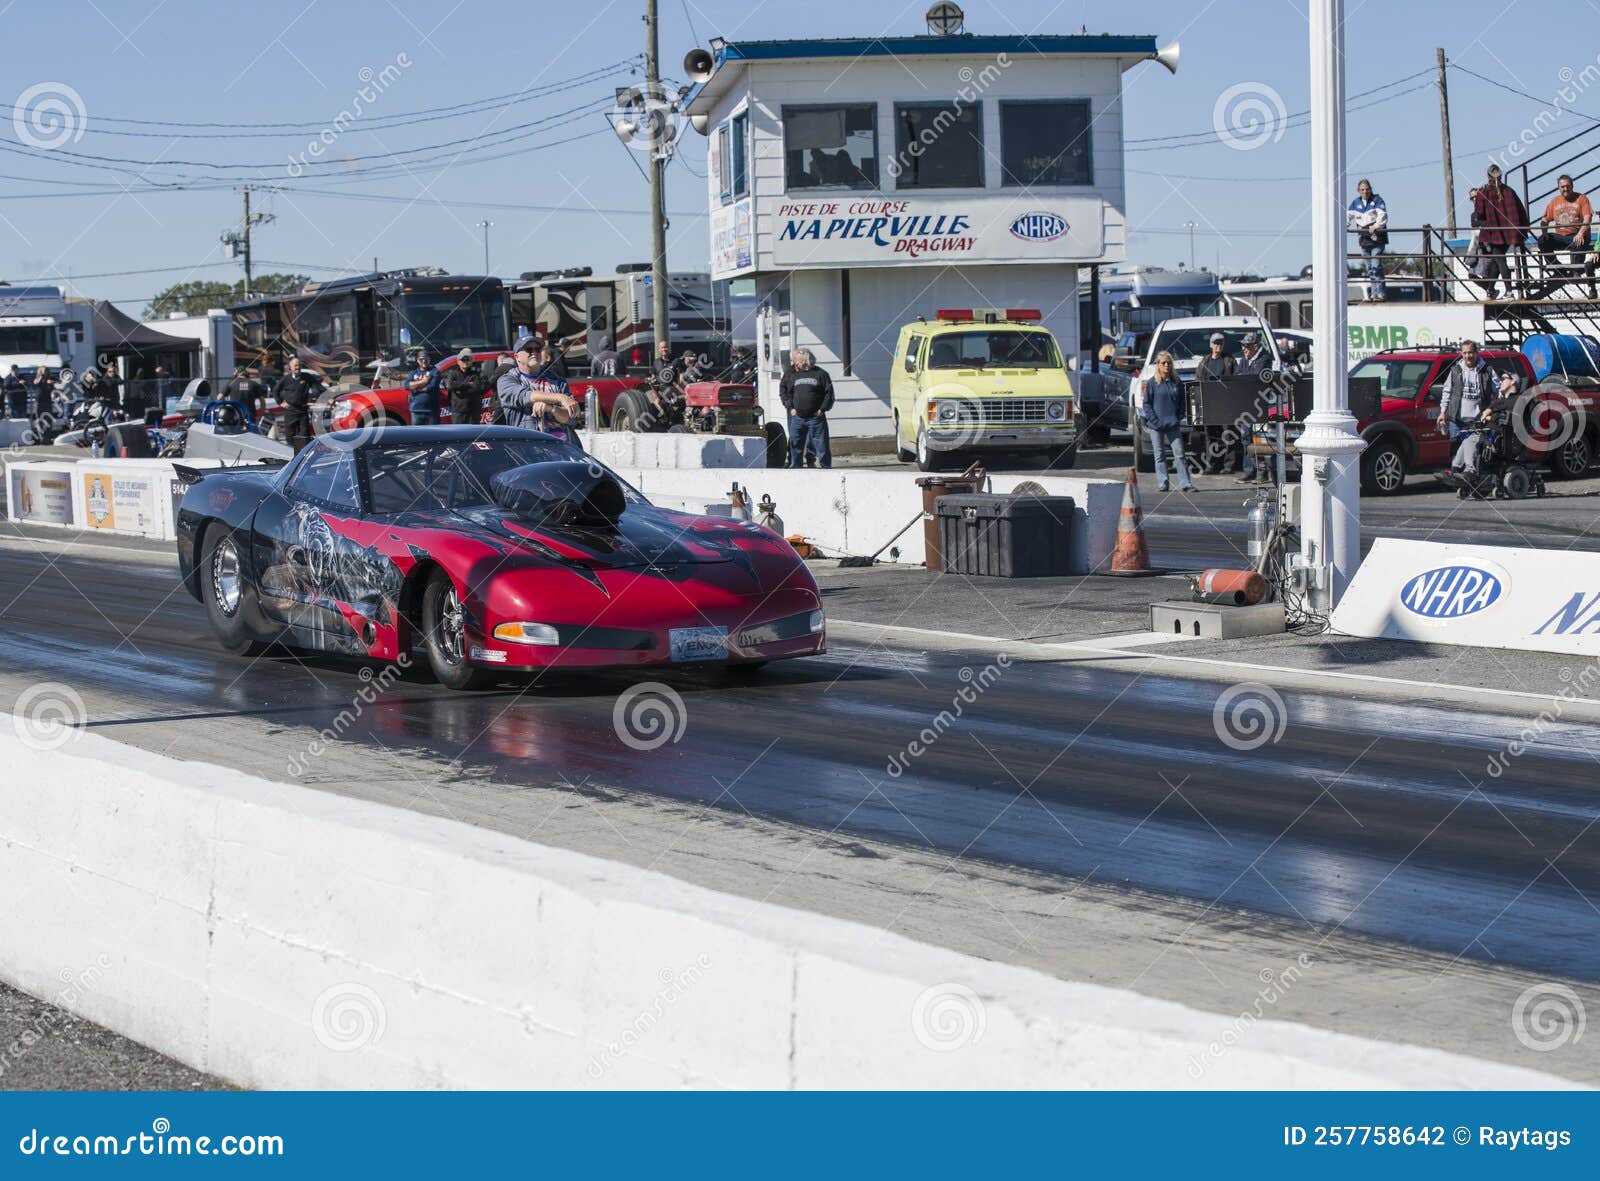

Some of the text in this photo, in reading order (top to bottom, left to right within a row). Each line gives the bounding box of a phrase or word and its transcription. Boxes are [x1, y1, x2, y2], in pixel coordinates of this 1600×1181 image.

[778, 201, 910, 217] PISTE DE COURSE
[779, 215, 970, 246] NAPIERVILLE
[1017, 216, 1062, 236] NHRA
[893, 237, 977, 257] DRAGWAY
[1348, 325, 1409, 349] BMR
[1405, 568, 1496, 617] NHRA
